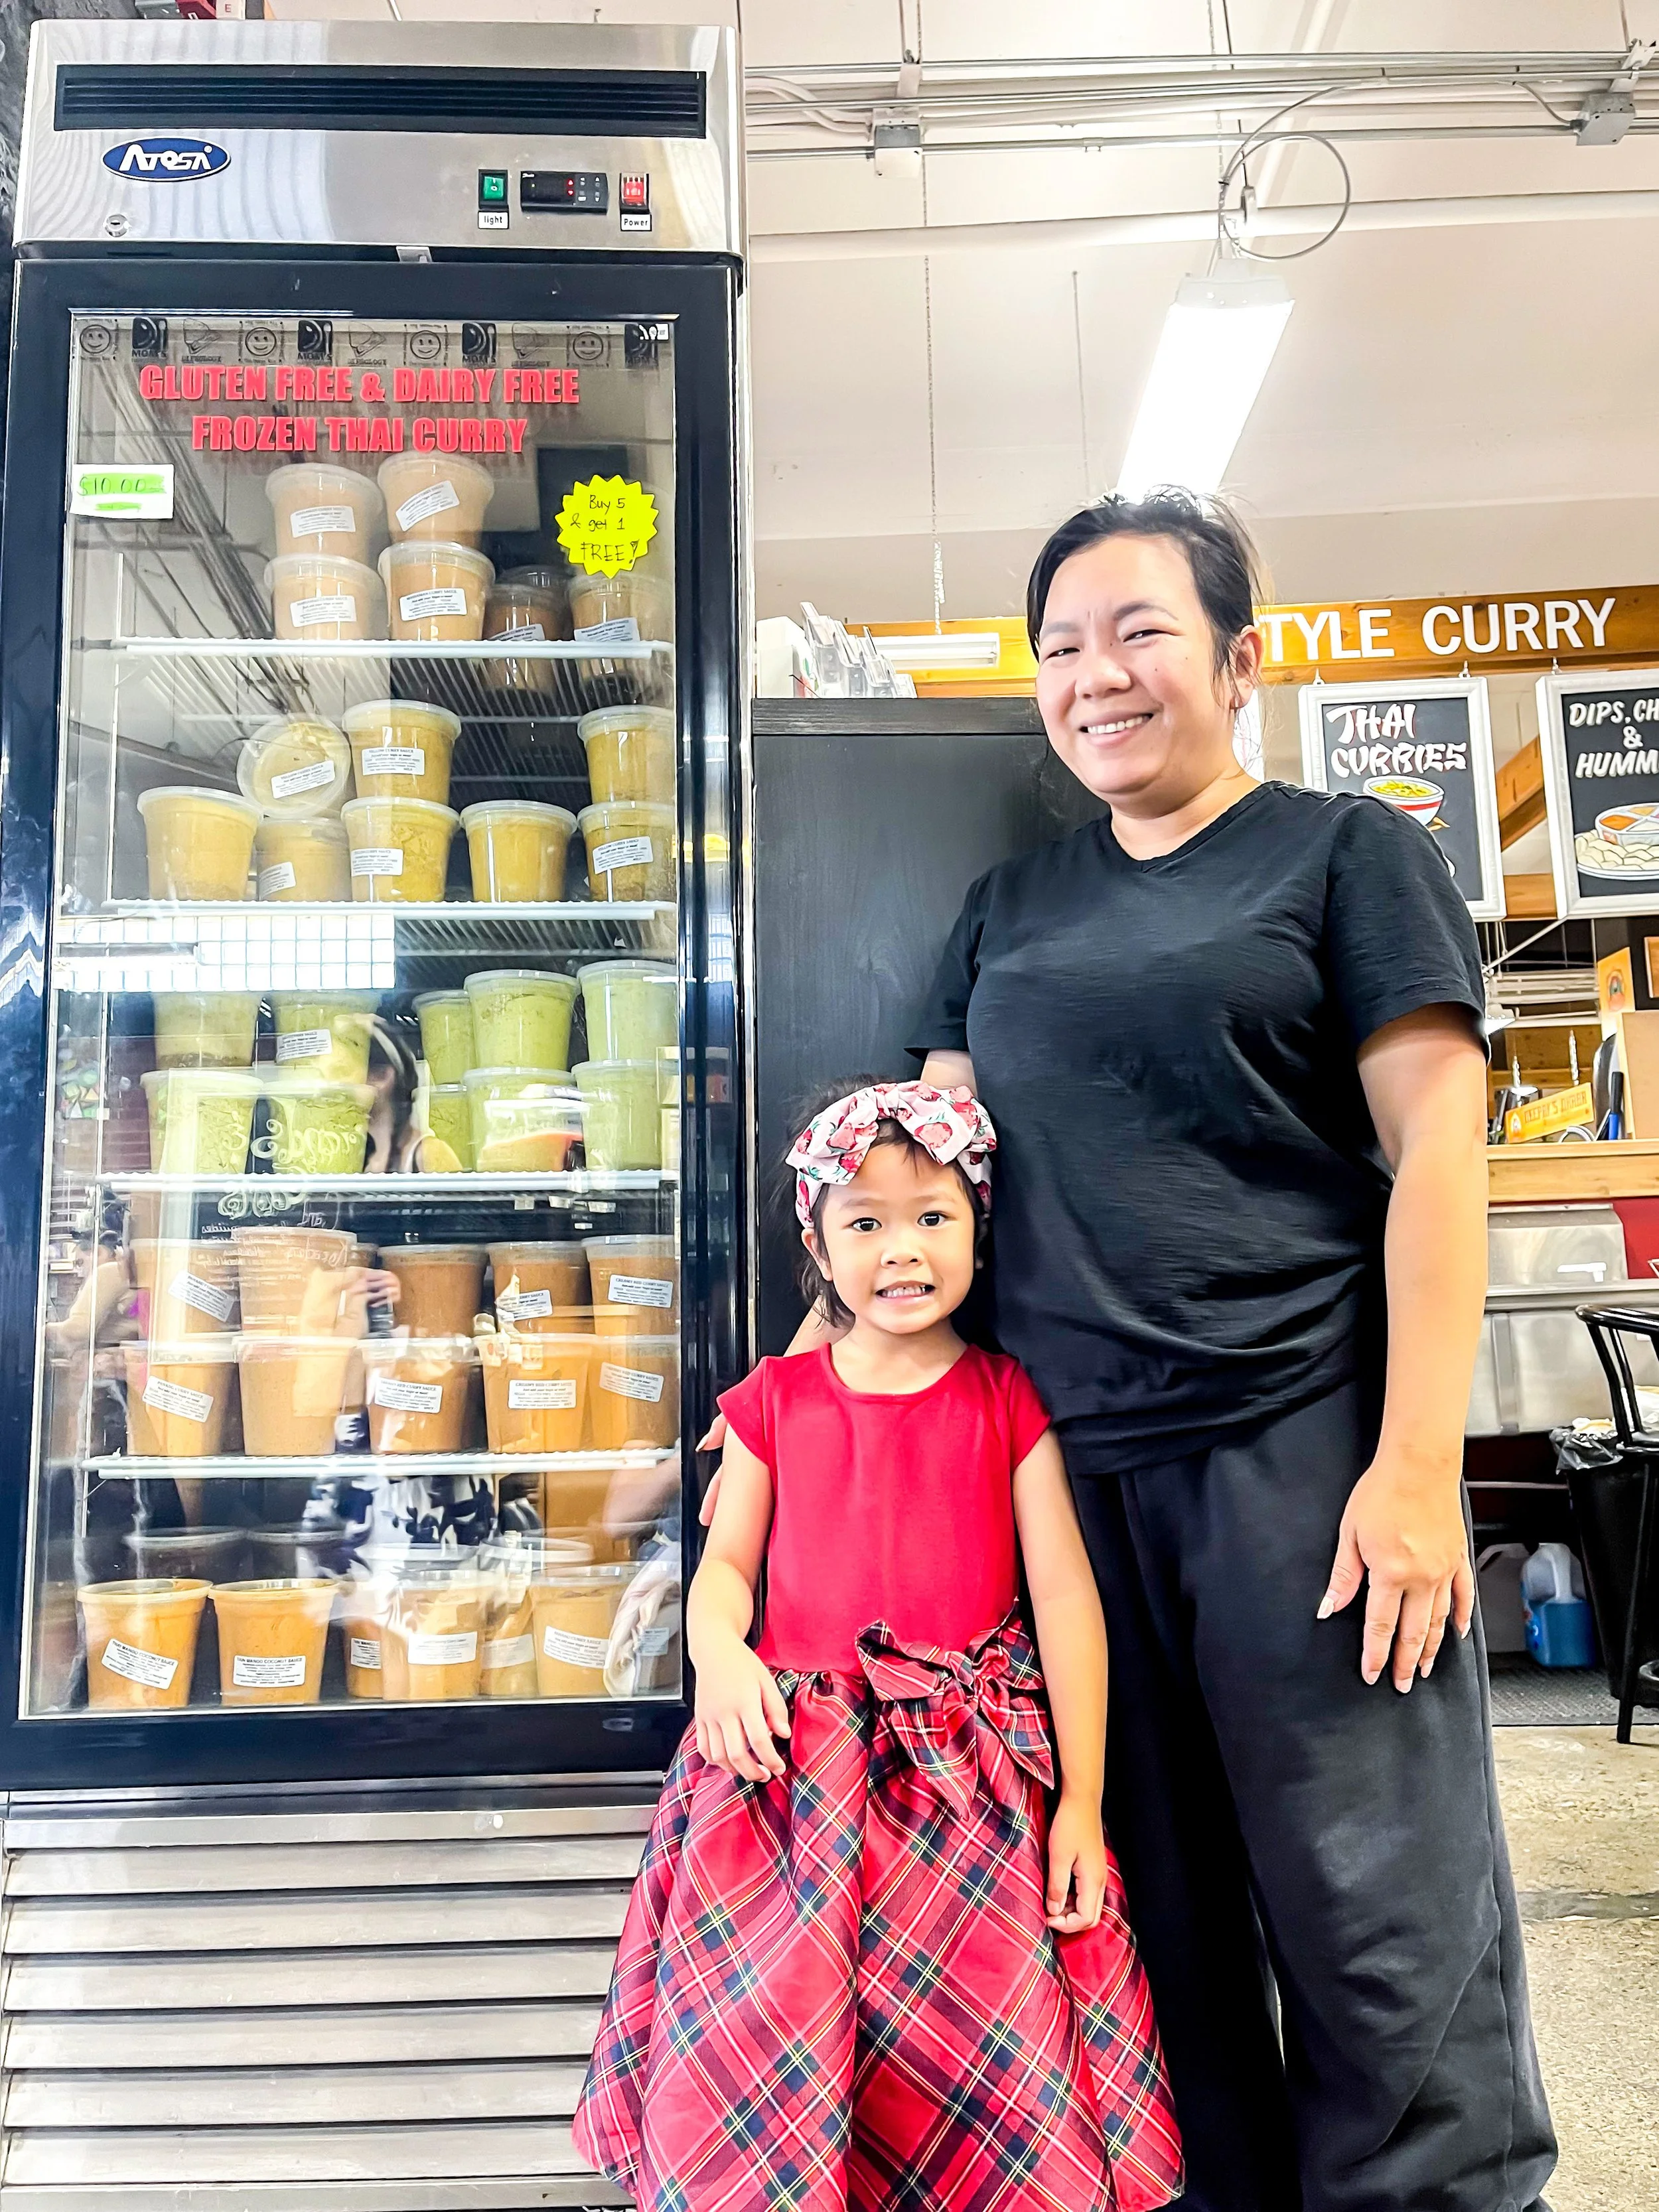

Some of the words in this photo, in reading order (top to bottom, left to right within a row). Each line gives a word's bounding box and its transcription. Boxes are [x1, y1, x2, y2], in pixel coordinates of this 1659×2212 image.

[484, 216, 502, 225] light
[139, 364, 266, 401] GLUTEN
[274, 366, 352, 402] FREE
[359, 372, 386, 403] &
[393, 368, 496, 403] DAIRY
[503, 368, 580, 404] FREE
[192, 415, 317, 452] FROZEN
[324, 416, 404, 452] THAI
[411, 418, 528, 453] CURRY
[77, 475, 147, 497] $10.00
[589, 494, 611, 515] Buy
[616, 498, 626, 509] 5
[570, 513, 581, 529] &
[588, 519, 607, 532] get
[617, 518, 625, 530] 1
[1421, 597, 1617, 656] CURRY
[1325, 703, 1417, 744] THAI
[1623, 725, 1644, 750] &
[1331, 741, 1467, 778] CURRIES
